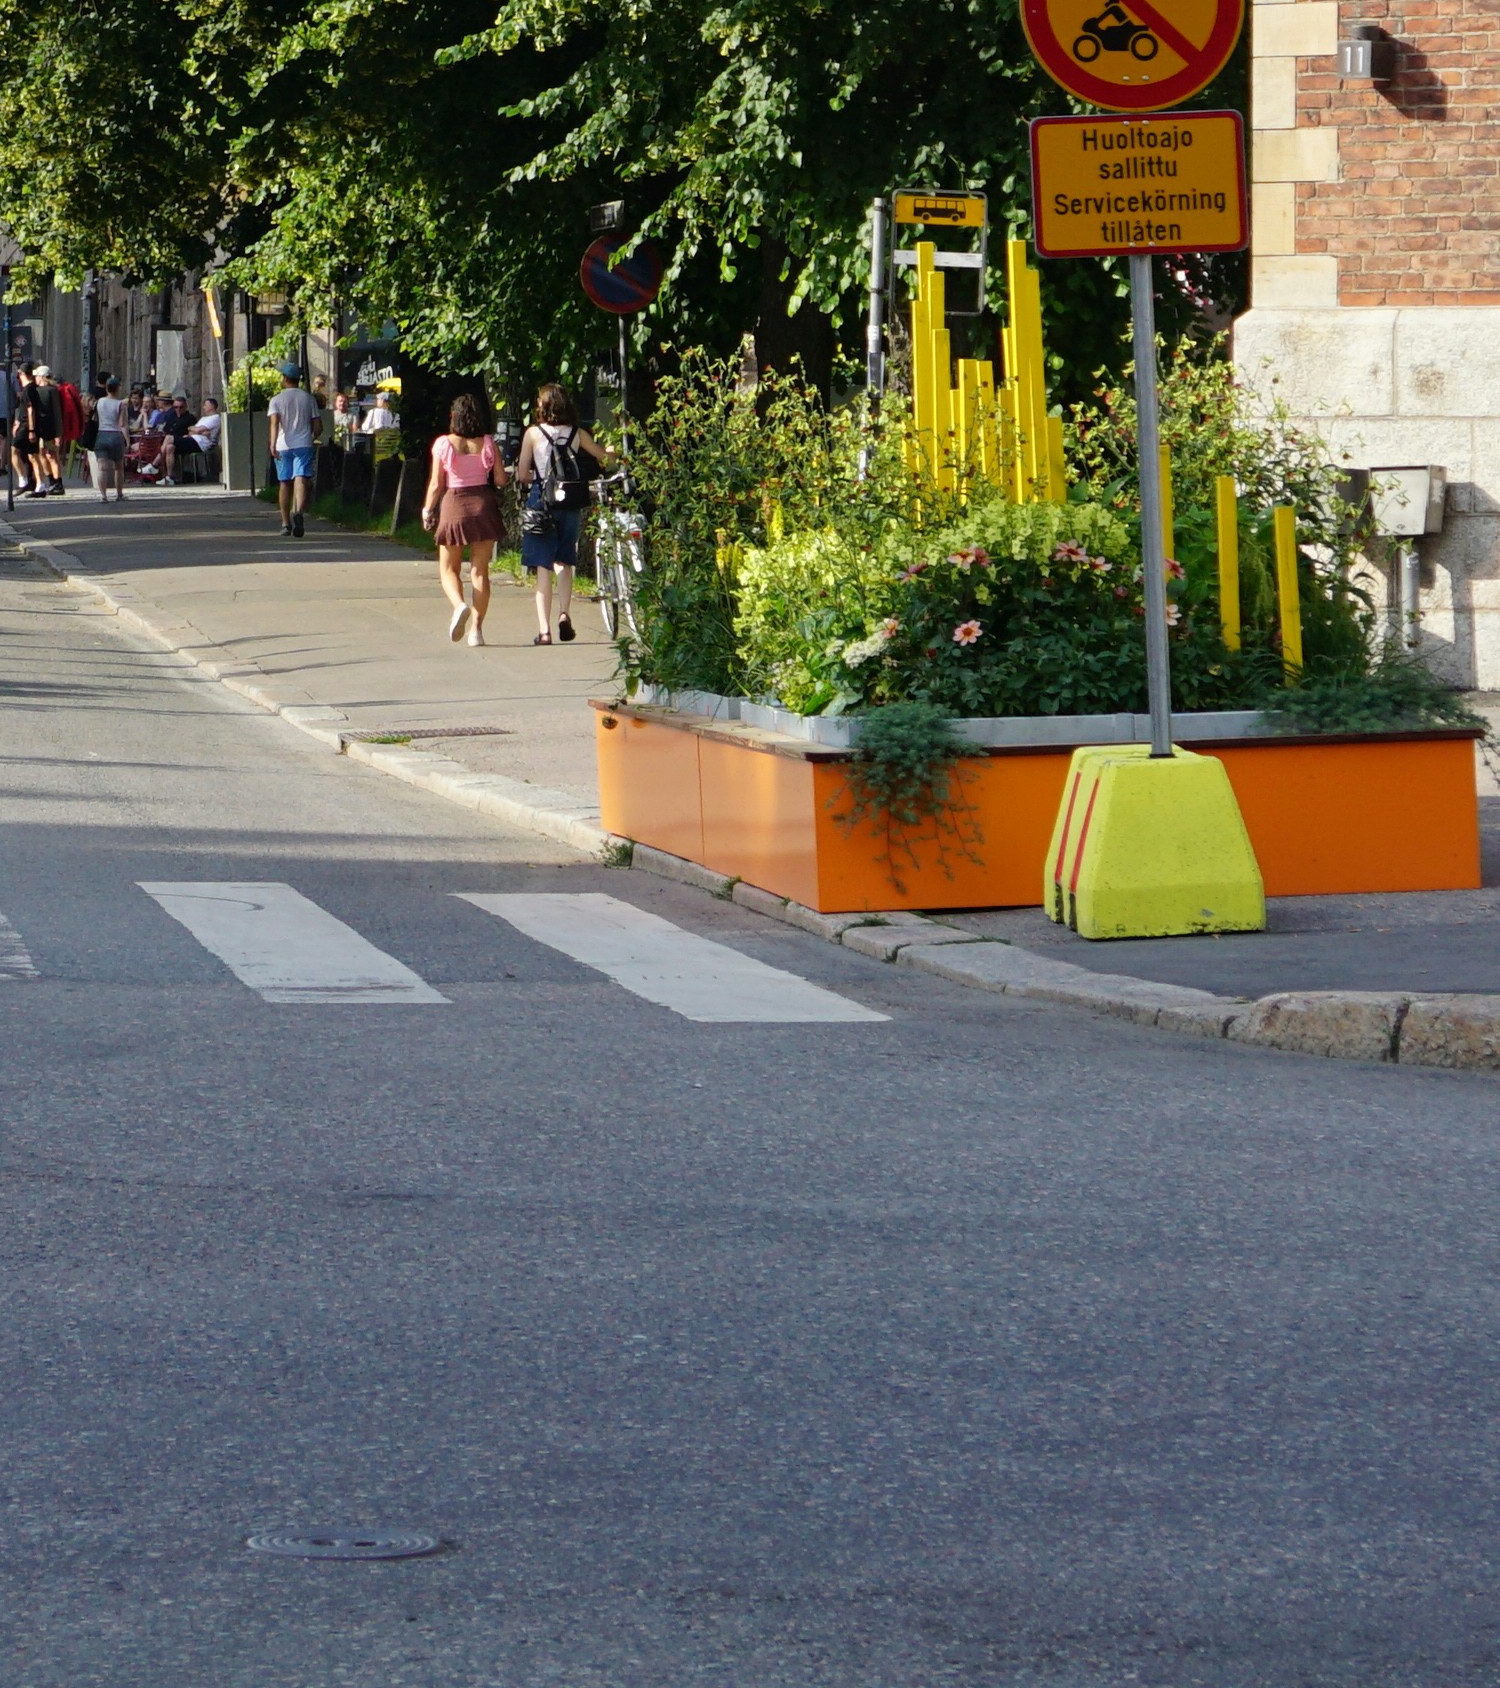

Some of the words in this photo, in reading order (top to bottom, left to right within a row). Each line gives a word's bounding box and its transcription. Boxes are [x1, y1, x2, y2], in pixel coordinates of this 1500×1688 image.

[1345, 46, 1363, 73] 11
[1082, 126, 1193, 151] Huoltoajo
[1099, 156, 1178, 180] sallittu
[1054, 188, 1227, 216] Servicekörning
[1101, 220, 1182, 243] tillåten
